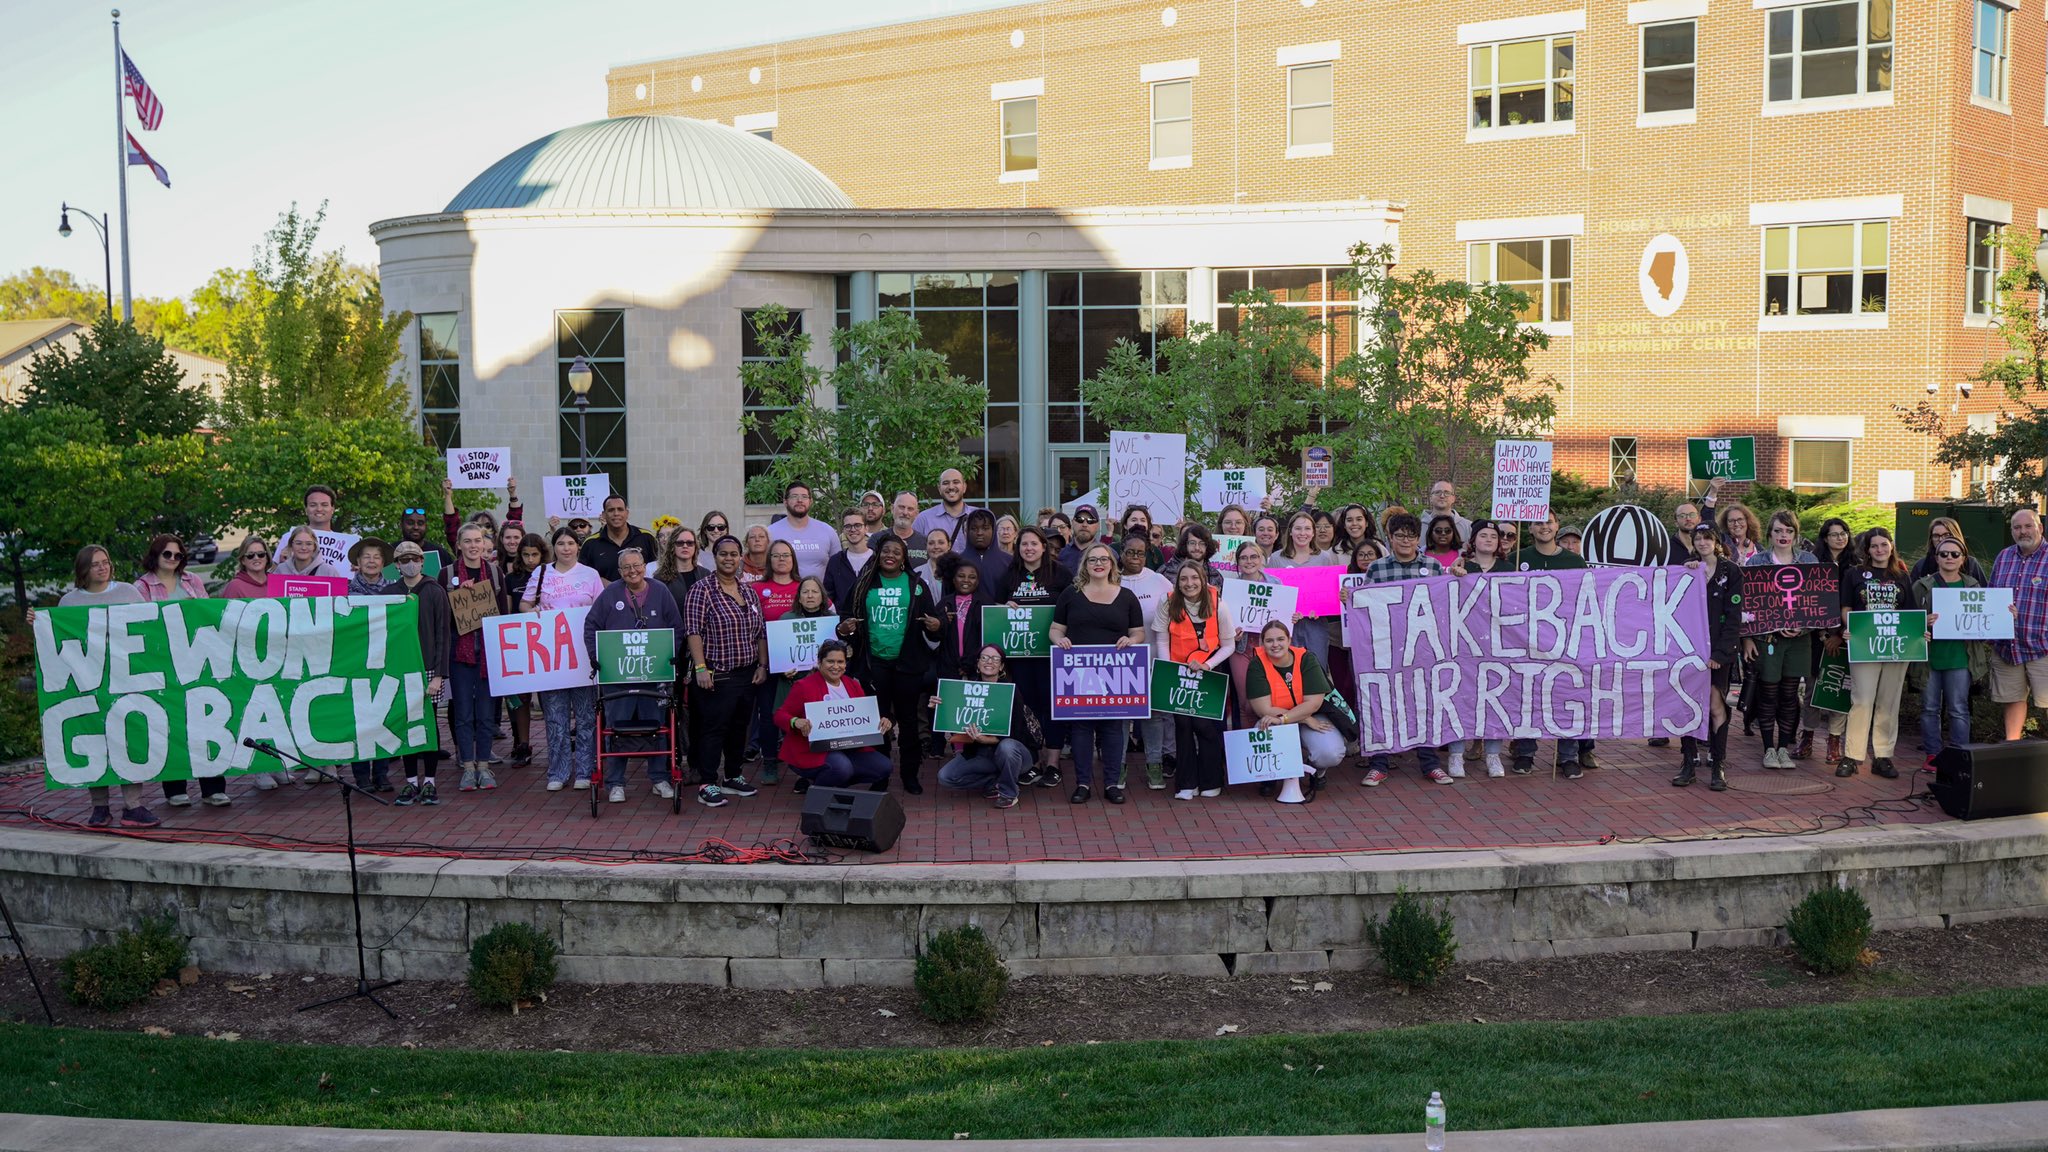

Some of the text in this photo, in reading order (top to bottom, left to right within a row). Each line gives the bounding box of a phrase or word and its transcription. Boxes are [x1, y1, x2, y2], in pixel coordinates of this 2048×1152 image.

[1671, 212, 1733, 229] WILSON
[1597, 319, 1728, 335] BOONE COUNTY
[1574, 337, 1757, 353] GOVERNMENT CENTER
[1115, 437, 1140, 454] WE
[1498, 444, 1538, 458] WHY DO
[1708, 440, 1732, 450] ROE
[468, 451, 490, 461] STOP
[1711, 451, 1730, 460] THE
[459, 461, 500, 474] ABORTION
[1115, 457, 1166, 476] WON'T
[1497, 458, 1550, 473] GUNS HAVE
[1705, 459, 1739, 475] VOTE
[468, 472, 490, 481] BANS
[565, 477, 587, 488] ROE
[1224, 471, 1245, 481] ROE
[1497, 474, 1550, 486] MORE RIGHTS
[568, 488, 585, 496] THE
[1114, 479, 1140, 498] GO
[1226, 482, 1243, 490] THE
[1496, 487, 1543, 498] THAN THOSE
[562, 496, 595, 512] VOTE
[1219, 491, 1252, 506] VOTE
[1495, 504, 1548, 520] GIVE BIRTH?
[318, 536, 336, 546] TOP
[1583, 506, 1668, 566] NOW
[320, 547, 346, 562] RTION
[1808, 567, 1832, 579] MY
[878, 588, 902, 597] ROE
[1248, 584, 1273, 597] ROE
[1743, 580, 1839, 596] OTTING CORPSE
[453, 587, 492, 610] My Body
[880, 597, 899, 606] THE
[1250, 597, 1268, 608] THE
[1744, 595, 1766, 609] EST
[1795, 595, 1819, 607] THE
[1960, 591, 1986, 602] ROE
[871, 606, 907, 624] VOTE
[1007, 608, 1032, 620] ROE
[1752, 607, 1827, 621] TEPS OF THE
[1962, 604, 1983, 613] THE
[456, 615, 472, 631] My
[1010, 621, 1030, 631] THE
[1353, 568, 1695, 670] TAKE BACK
[1740, 616, 1840, 635] SUPREME COURT
[1873, 613, 1900, 625] ROE
[1955, 614, 1995, 631] VOTE
[792, 621, 817, 633] ROE
[1877, 626, 1897, 636] THE
[34, 594, 407, 695] WE WON'T
[498, 611, 579, 678] ERA
[622, 632, 648, 645] ROE
[796, 634, 815, 644] THE
[1002, 631, 1040, 650] VOTE
[1869, 635, 1908, 655] VOTE
[625, 646, 646, 656] THE
[789, 643, 820, 664] VOT
[618, 656, 656, 675] VOTE
[1063, 653, 1136, 666] BETHANY
[1177, 665, 1204, 680] ROE
[1056, 666, 1146, 696] MANN
[1179, 678, 1199, 690] THE
[963, 684, 989, 696] ROE
[1475, 654, 1708, 740] RIGHTS
[965, 697, 985, 707] THE
[1086, 697, 1146, 705] MISSOURI
[1169, 687, 1209, 709] VOTE
[827, 704, 855, 715] FUND
[956, 707, 994, 726] VOTE
[42, 670, 428, 786] GO BACK!
[818, 716, 870, 730] ABORTION
[1248, 729, 1273, 742] ROE
[1252, 743, 1272, 754] THE
[1246, 752, 1283, 774] VOTE
